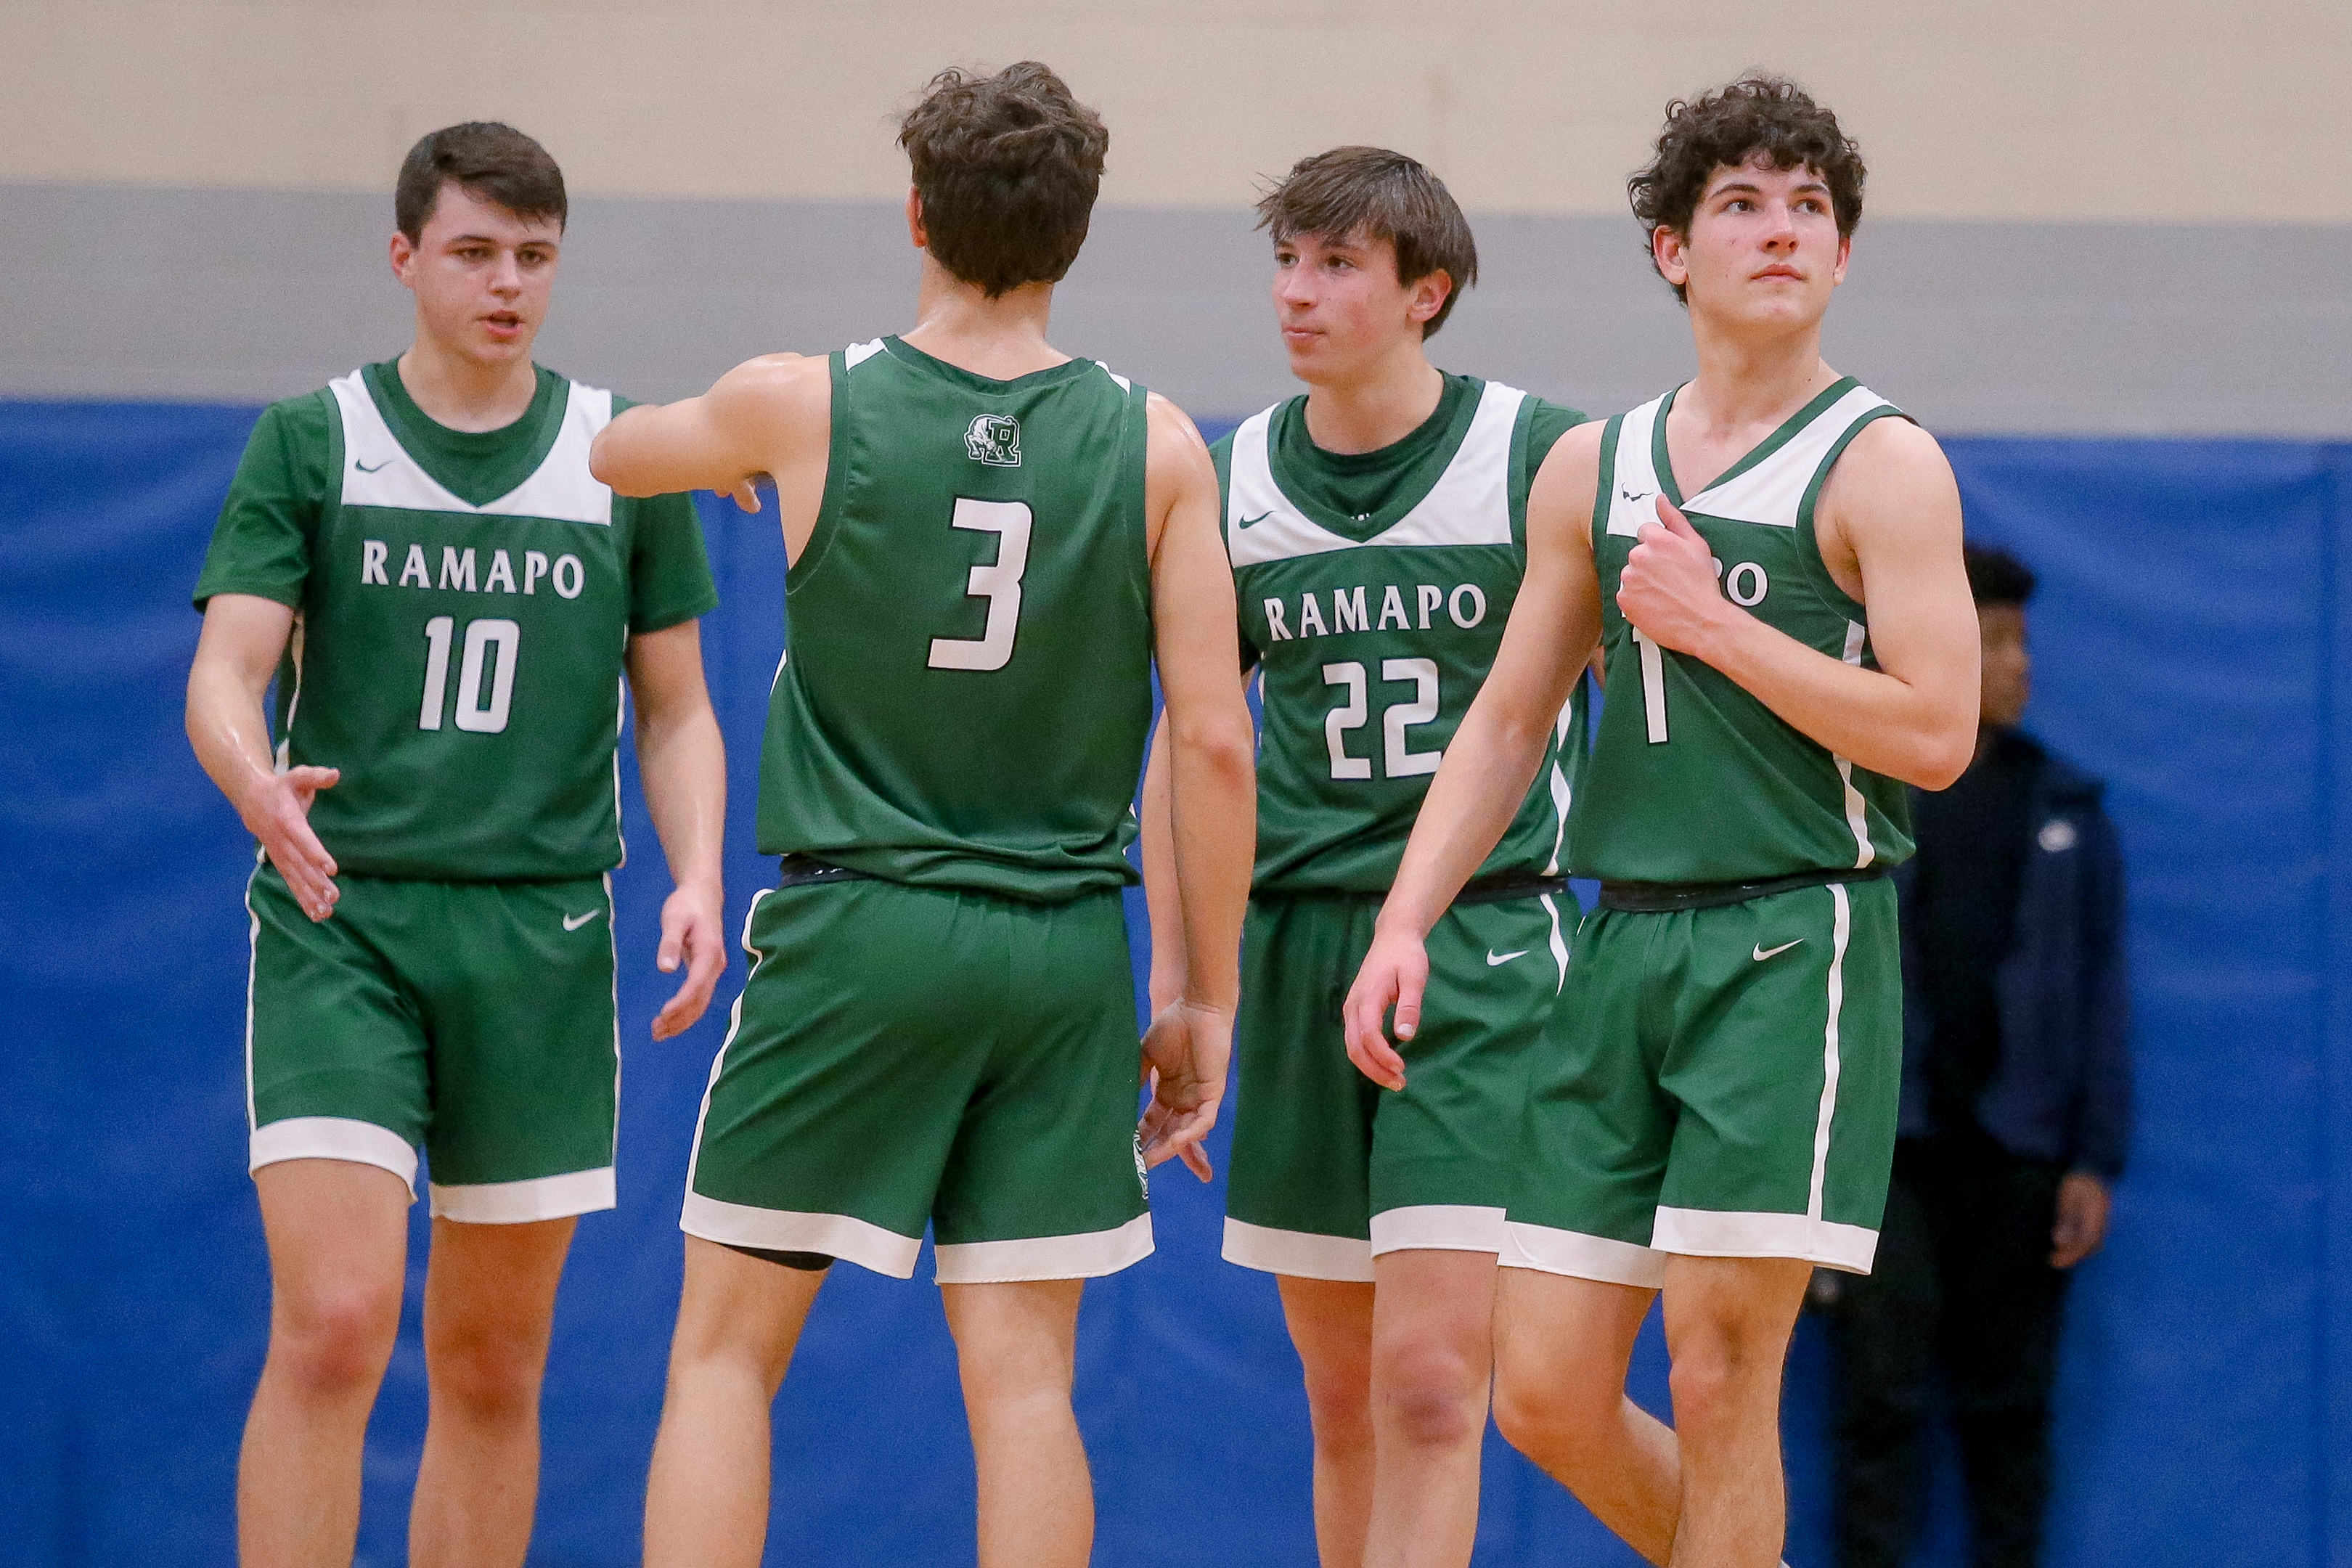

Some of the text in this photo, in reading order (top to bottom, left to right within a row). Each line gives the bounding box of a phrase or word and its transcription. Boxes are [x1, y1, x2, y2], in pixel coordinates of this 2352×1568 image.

[362, 539, 585, 600] RAMAPO
[927, 497, 1033, 671] 3
[1263, 583, 1487, 642] RAMAPO
[418, 616, 520, 733] 10
[1323, 658, 1442, 780] 22
[1633, 625, 1668, 744] 1
